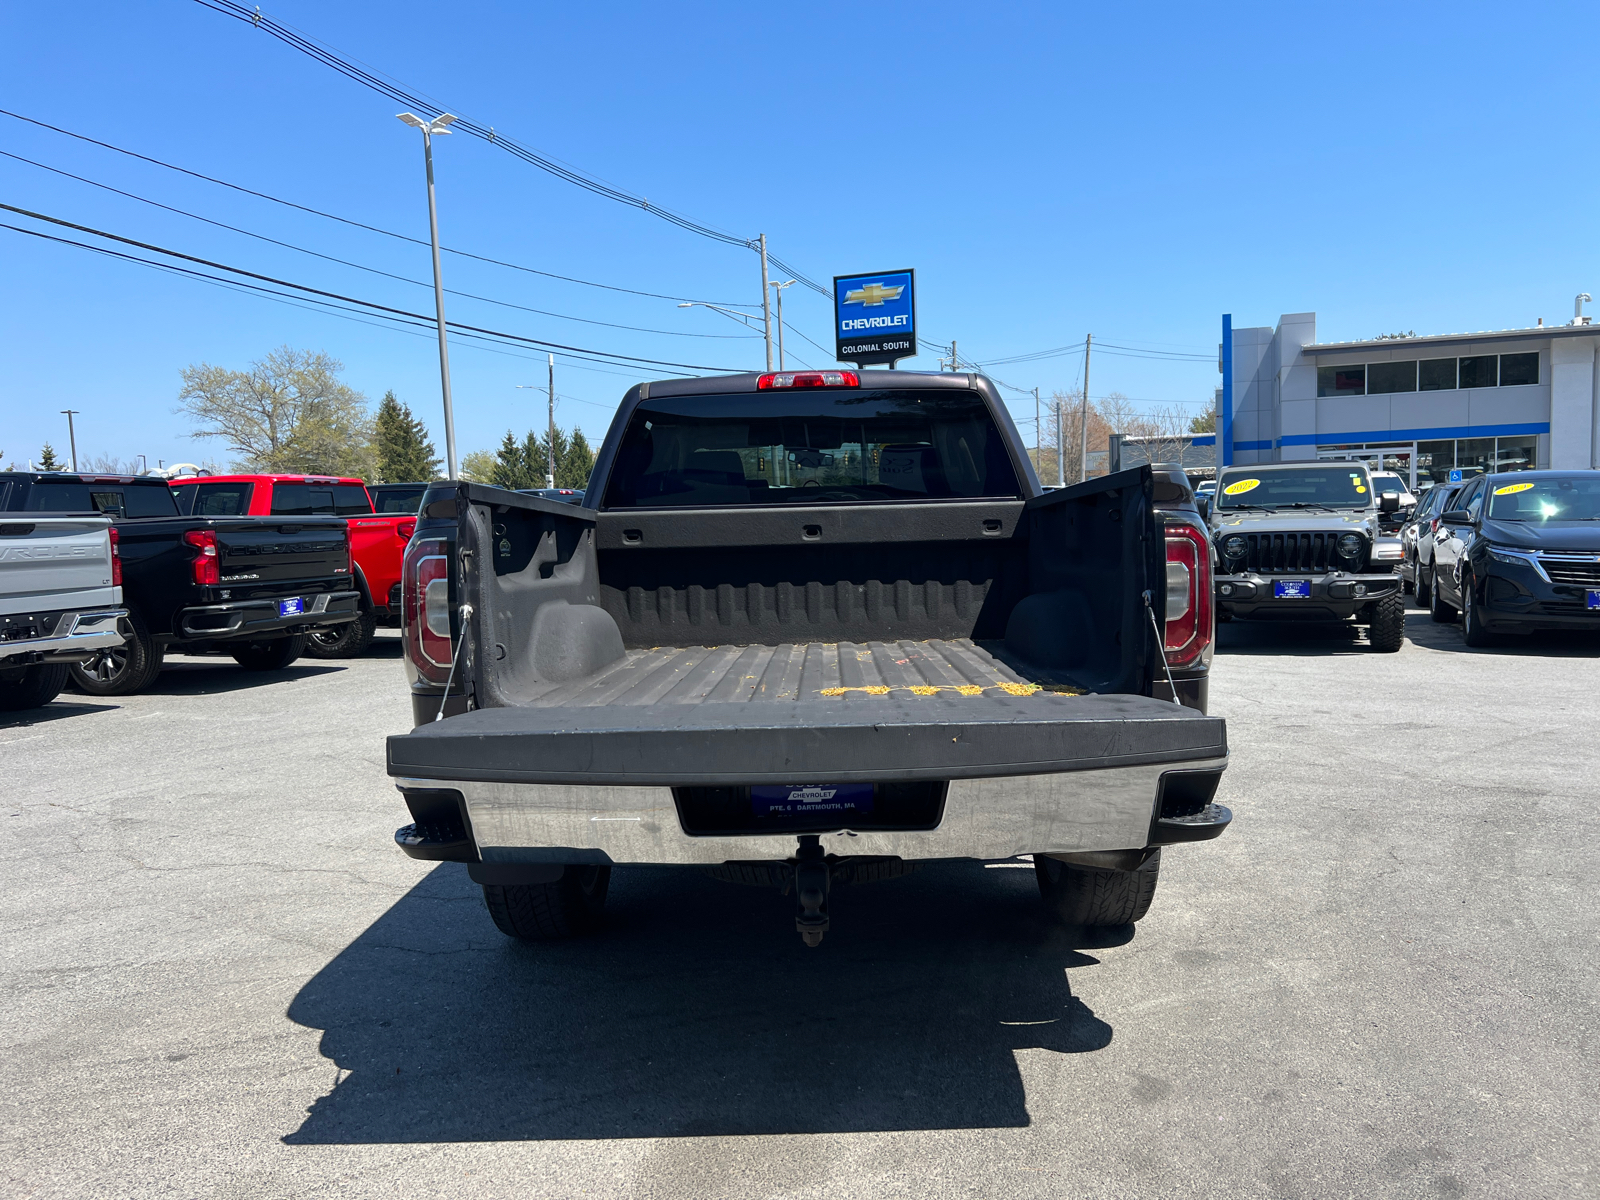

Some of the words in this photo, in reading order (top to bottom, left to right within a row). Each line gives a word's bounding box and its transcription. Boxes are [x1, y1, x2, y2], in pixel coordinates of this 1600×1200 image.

[842, 315, 908, 330] CHEVROLET
[842, 343, 880, 353] COLONIAL
[883, 341, 909, 351] SOUTH
[1231, 480, 1253, 493] 2022
[792, 791, 832, 799] CHEVROLET
